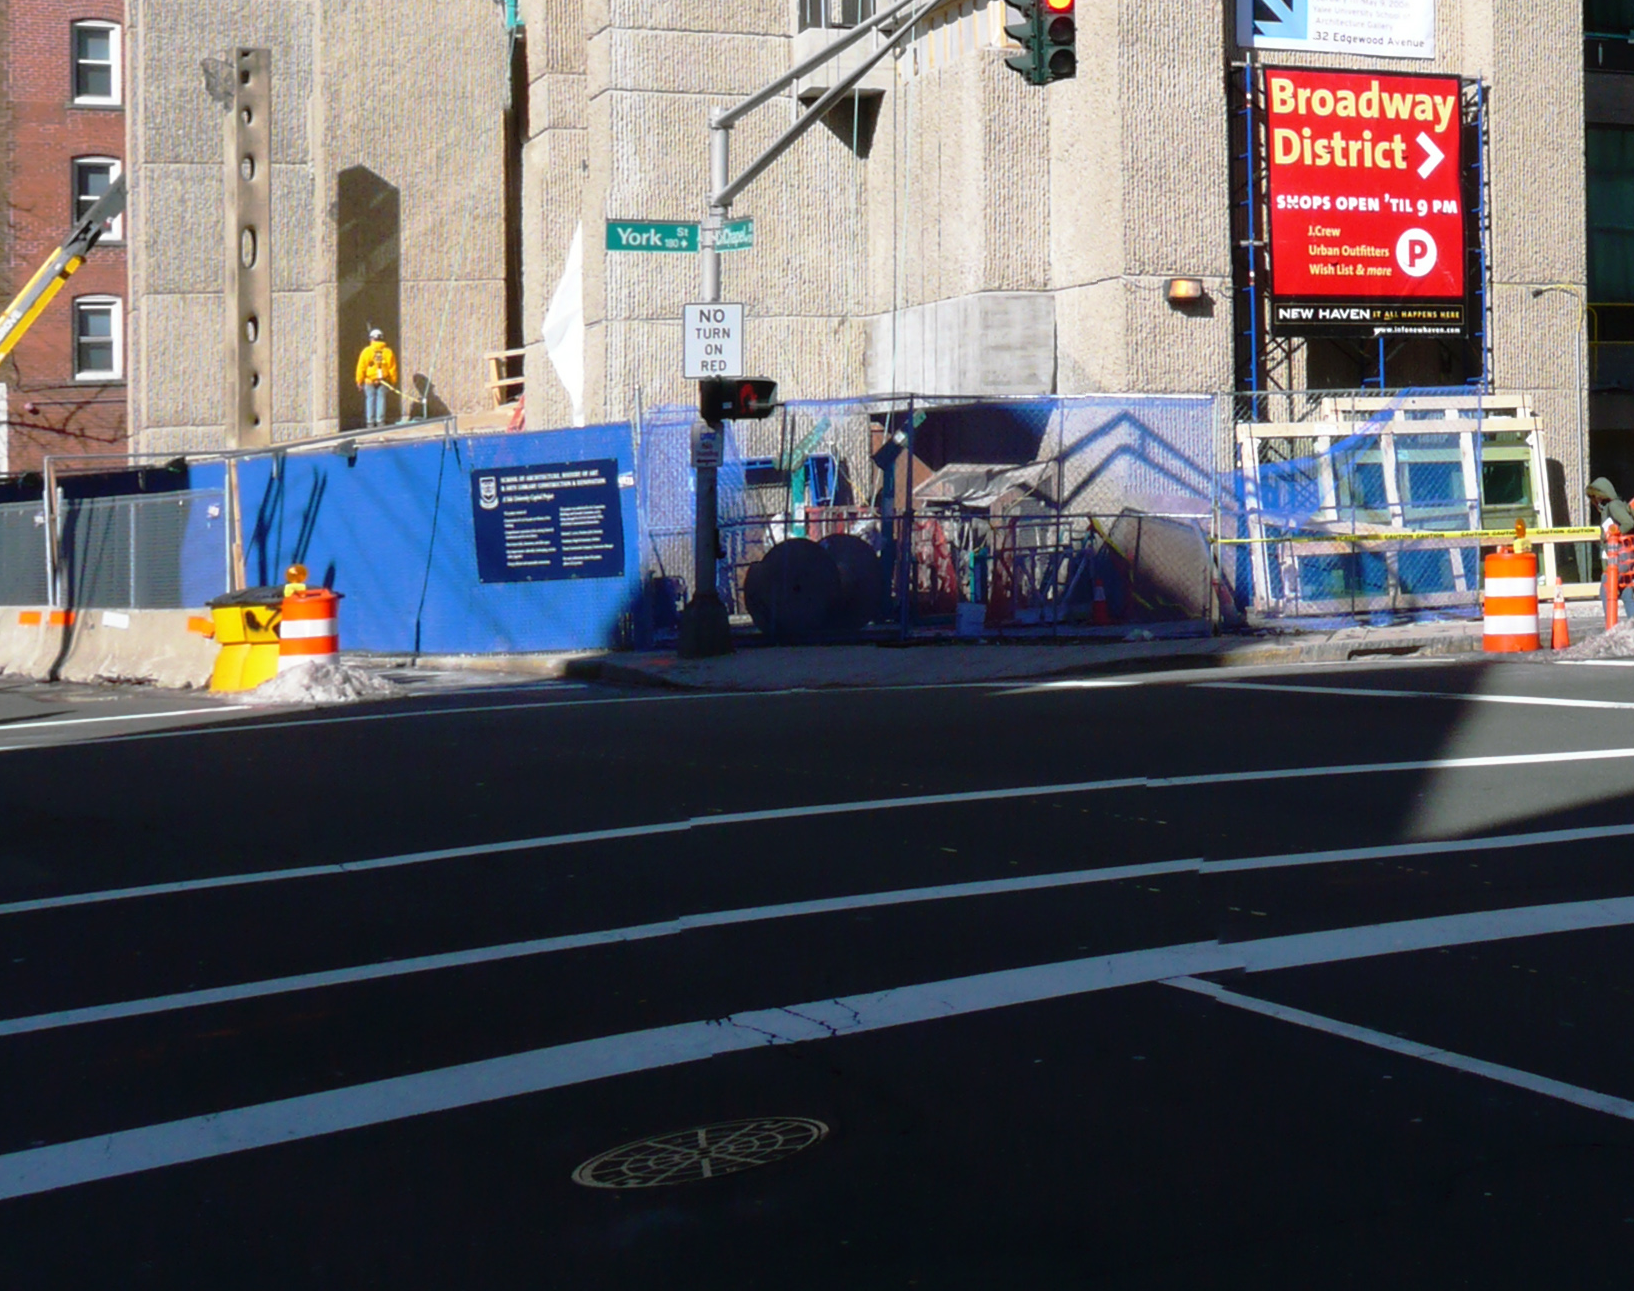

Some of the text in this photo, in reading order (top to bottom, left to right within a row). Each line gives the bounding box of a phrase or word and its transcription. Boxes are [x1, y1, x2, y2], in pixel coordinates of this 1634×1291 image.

[1332, 32, 1384, 46] Edgewood
[1387, 37, 1426, 48] Avenue
[1271, 77, 1456, 133] Broadway
[1273, 127, 1408, 170] District
[1276, 194, 1332, 211] SHOPS
[1335, 196, 1380, 212] OPEN
[1416, 199, 1428, 217] 9
[1432, 200, 1458, 214] PM
[617, 227, 663, 246] York
[676, 227, 689, 237] St
[1307, 225, 1341, 238] J.Crew
[1308, 244, 1390, 257] Urban Outfitters
[1408, 239, 1428, 268] P
[1309, 264, 1393, 277] Wish List & more
[699, 309, 726, 323] NO
[1278, 308, 1314, 319] NEW
[1318, 308, 1371, 319] HAVEN
[1401, 311, 1438, 319] HAPPENS
[1440, 311, 1461, 319] HERE
[695, 328, 731, 339] TURN
[704, 344, 723, 355] ON
[701, 360, 727, 372] RED
